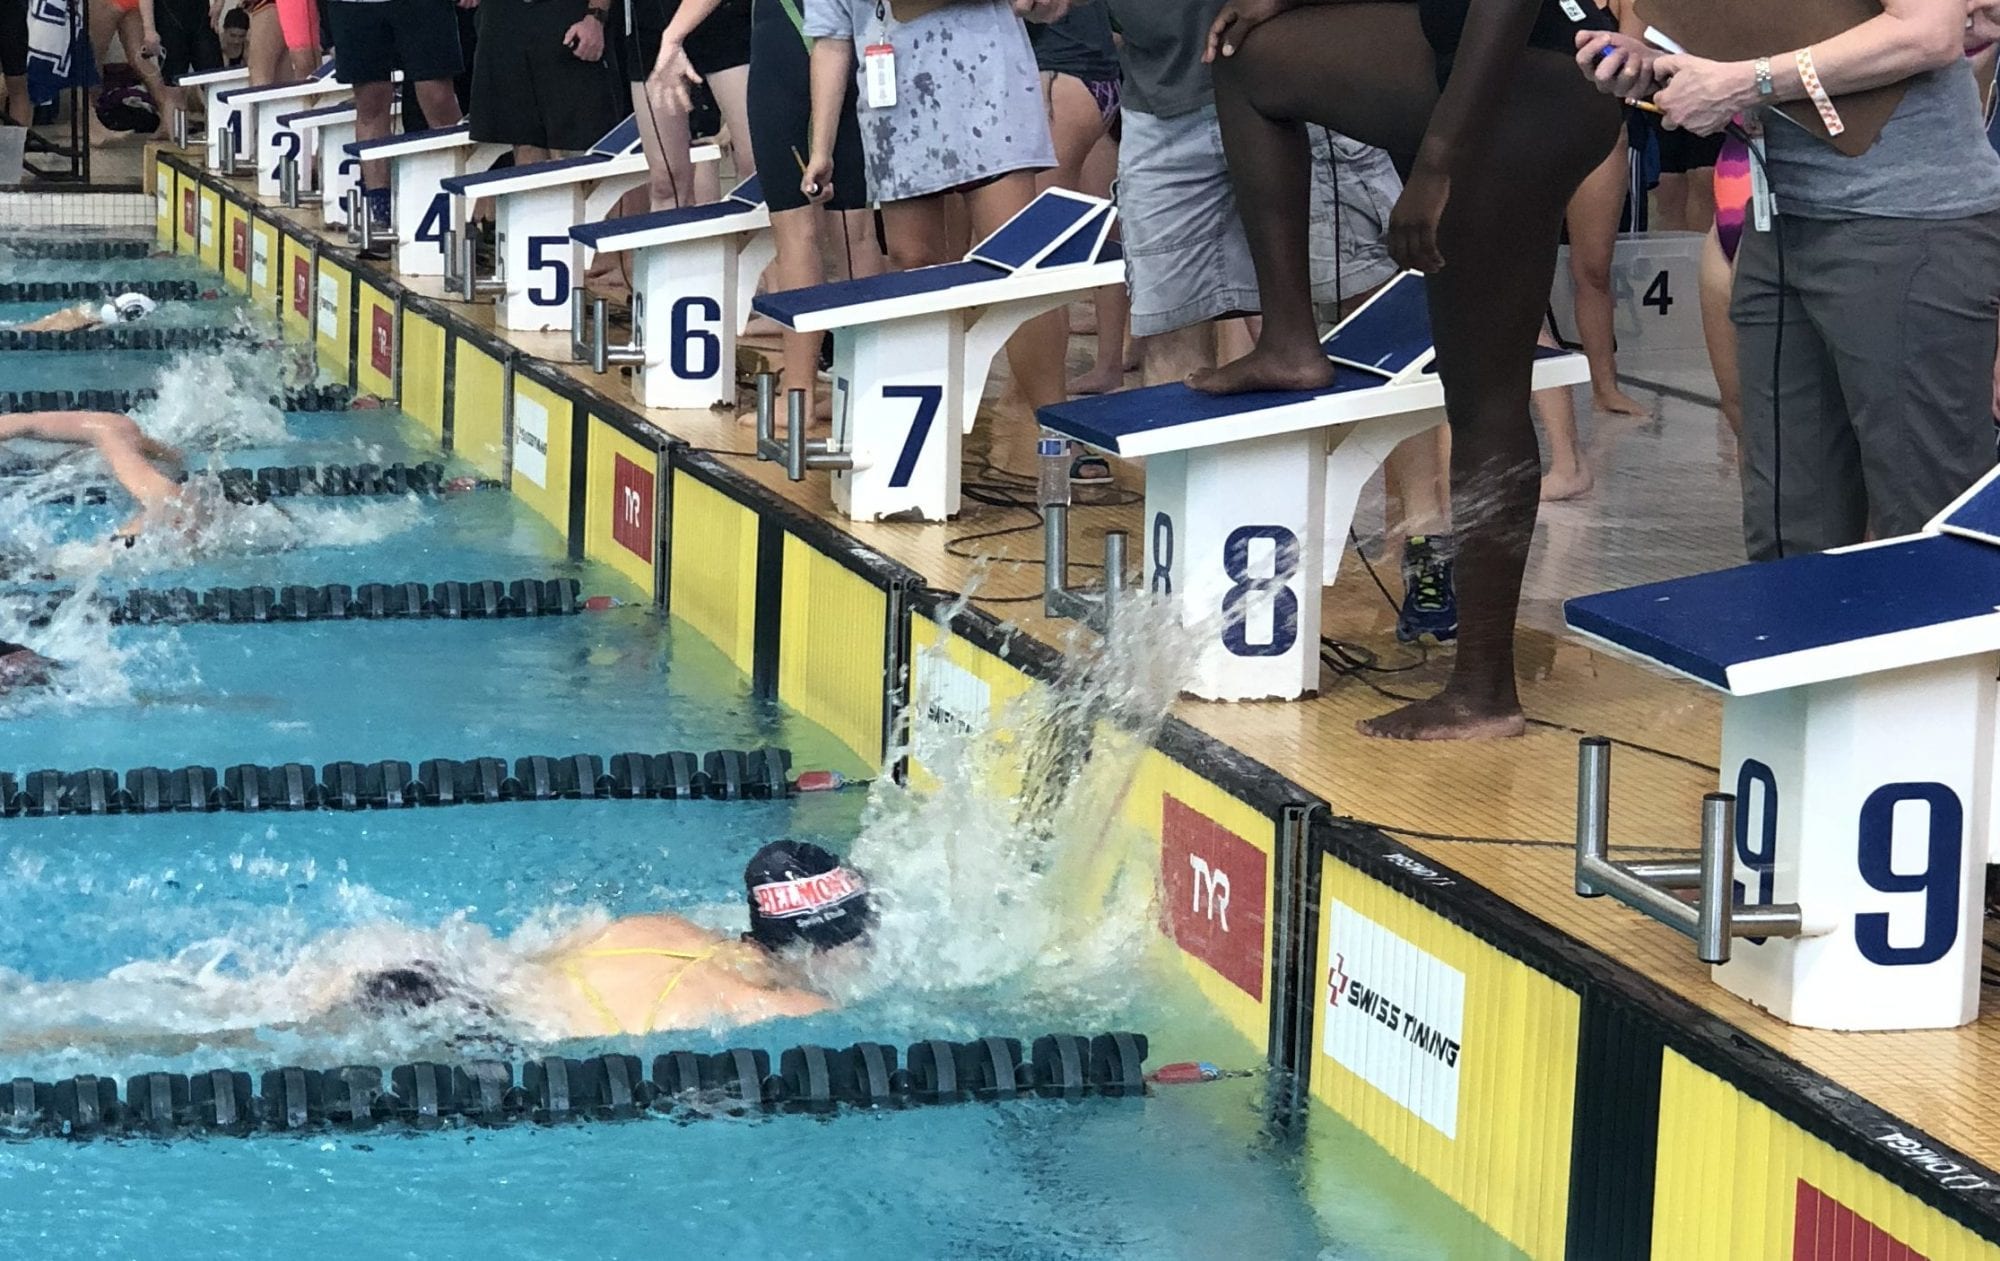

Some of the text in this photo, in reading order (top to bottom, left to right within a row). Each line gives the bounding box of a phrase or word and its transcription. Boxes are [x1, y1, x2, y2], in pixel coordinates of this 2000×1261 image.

[227, 110, 242, 153] 1
[271, 132, 300, 180] 2
[415, 193, 450, 254] 4
[528, 236, 569, 306] 5
[1643, 271, 1673, 315] 4
[671, 296, 721, 379] 6
[882, 385, 943, 487] 7
[625, 486, 640, 528] TYR
[1222, 525, 1300, 656] 8
[1733, 758, 1778, 946] 9
[1855, 782, 1963, 966] 9
[1190, 853, 1230, 932] TYR
[1347, 980, 1460, 1068] SWISS TIMING
